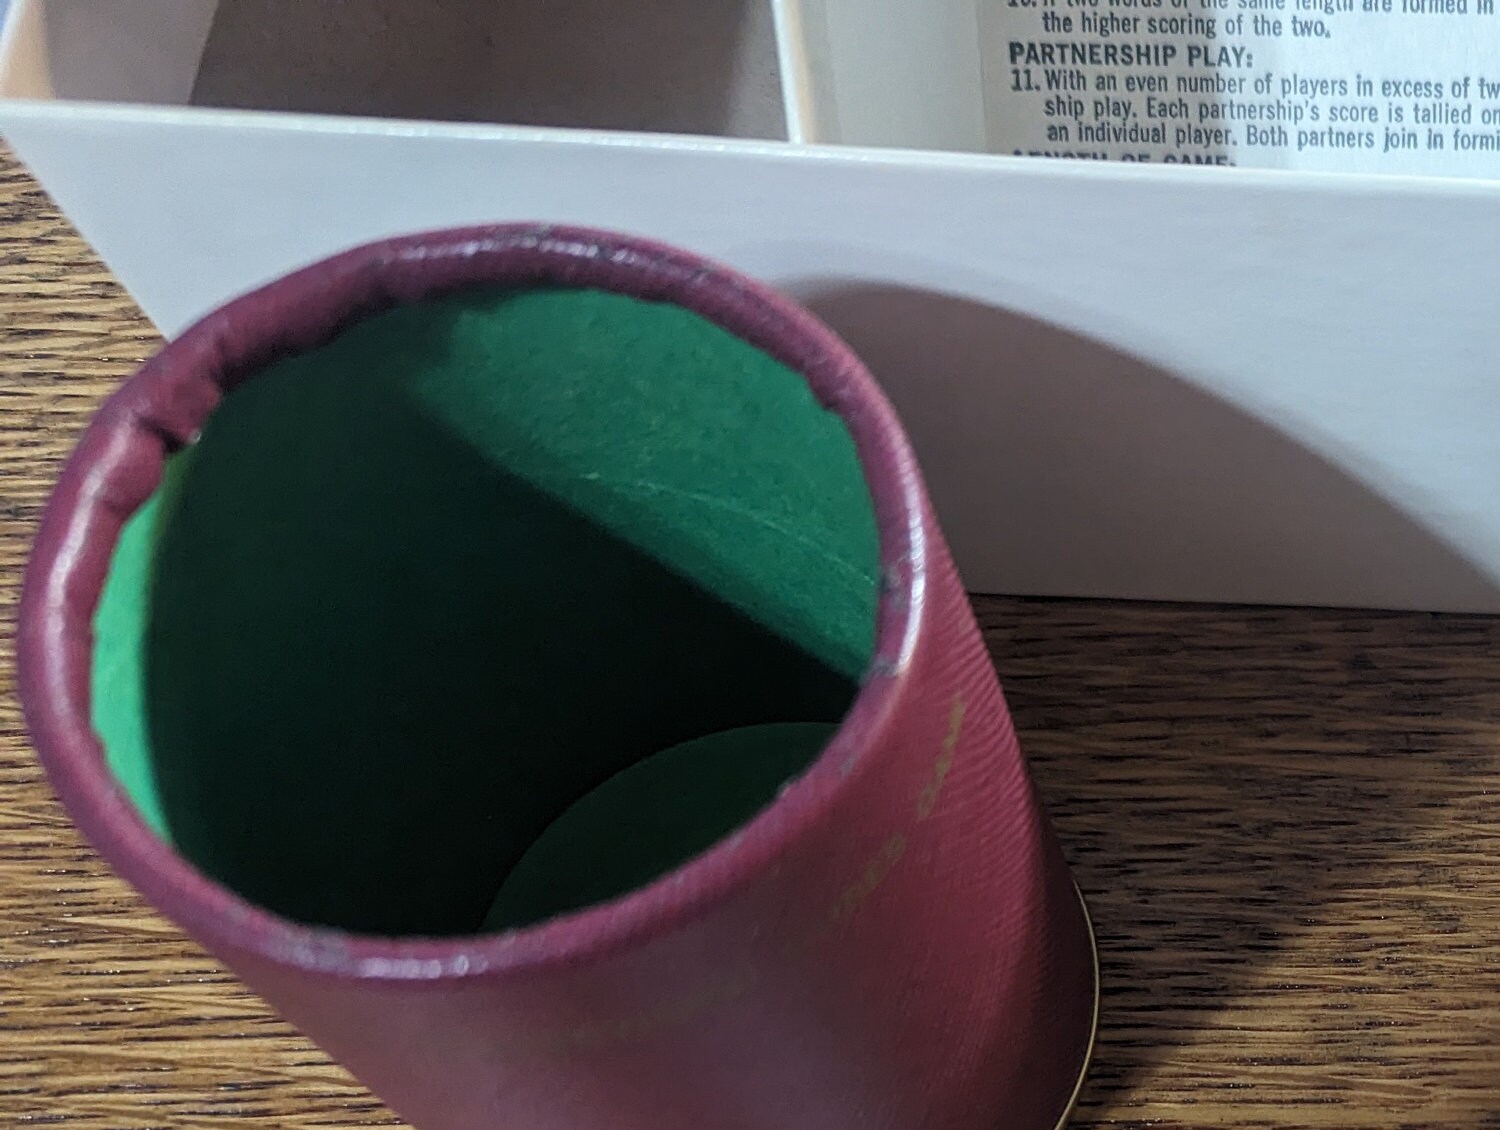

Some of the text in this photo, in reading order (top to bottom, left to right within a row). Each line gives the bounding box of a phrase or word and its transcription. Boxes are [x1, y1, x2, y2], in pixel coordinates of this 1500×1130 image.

[1042, 10, 1331, 39] the higher scoring of the two.
[1009, 41, 1253, 68] PARTNERSHIP PLAY:
[1011, 70, 1040, 92] 11.
[1046, 69, 1087, 91] With
[1095, 73, 1117, 91] an
[1125, 75, 1168, 93] even
[1177, 72, 1246, 94] number
[1254, 71, 1272, 94] of
[1281, 73, 1347, 99] players
[1357, 73, 1373, 97] in
[1382, 80, 1443, 99] excess
[1451, 76, 1470, 99] of
[1044, 95, 1084, 121] ship
[1093, 97, 1137, 122] play.
[1147, 95, 1189, 119] Each
[1198, 99, 1320, 125] partnership's
[1329, 105, 1378, 123] score
[1389, 102, 1403, 123] is
[1413, 102, 1471, 125] tallied
[1047, 124, 1069, 142] an
[1078, 122, 1166, 144] individual
[1175, 123, 1237, 149] player.
[1247, 124, 1288, 147] Both
[1298, 126, 1374, 151] partners
[1384, 126, 1418, 153] join
[1427, 128, 1444, 150] in
